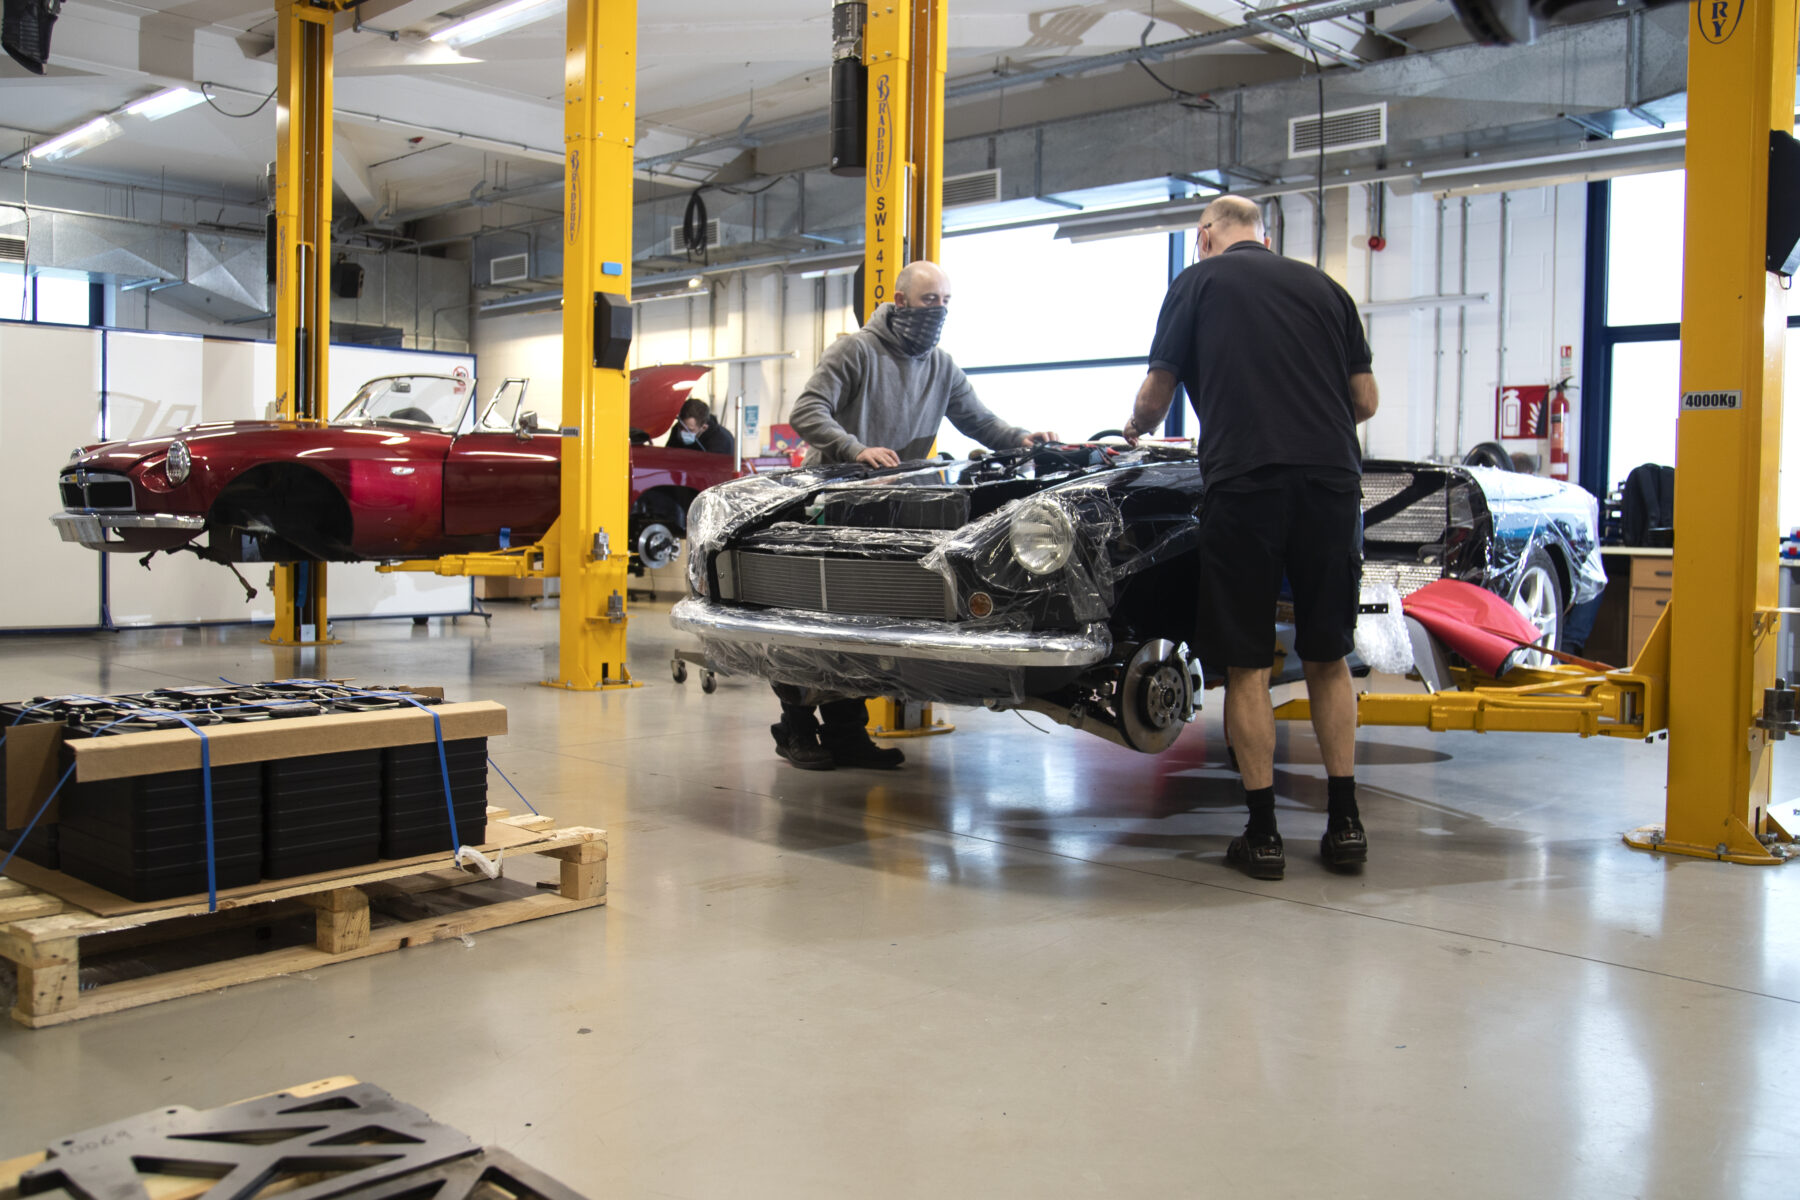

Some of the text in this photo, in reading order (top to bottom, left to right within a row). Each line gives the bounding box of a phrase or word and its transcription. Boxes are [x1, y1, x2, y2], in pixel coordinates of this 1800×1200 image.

[875, 74, 890, 188] BRADBURY
[874, 196, 888, 243] SWL
[875, 249, 884, 263] 4
[1685, 393, 1737, 408] 4000Kg
